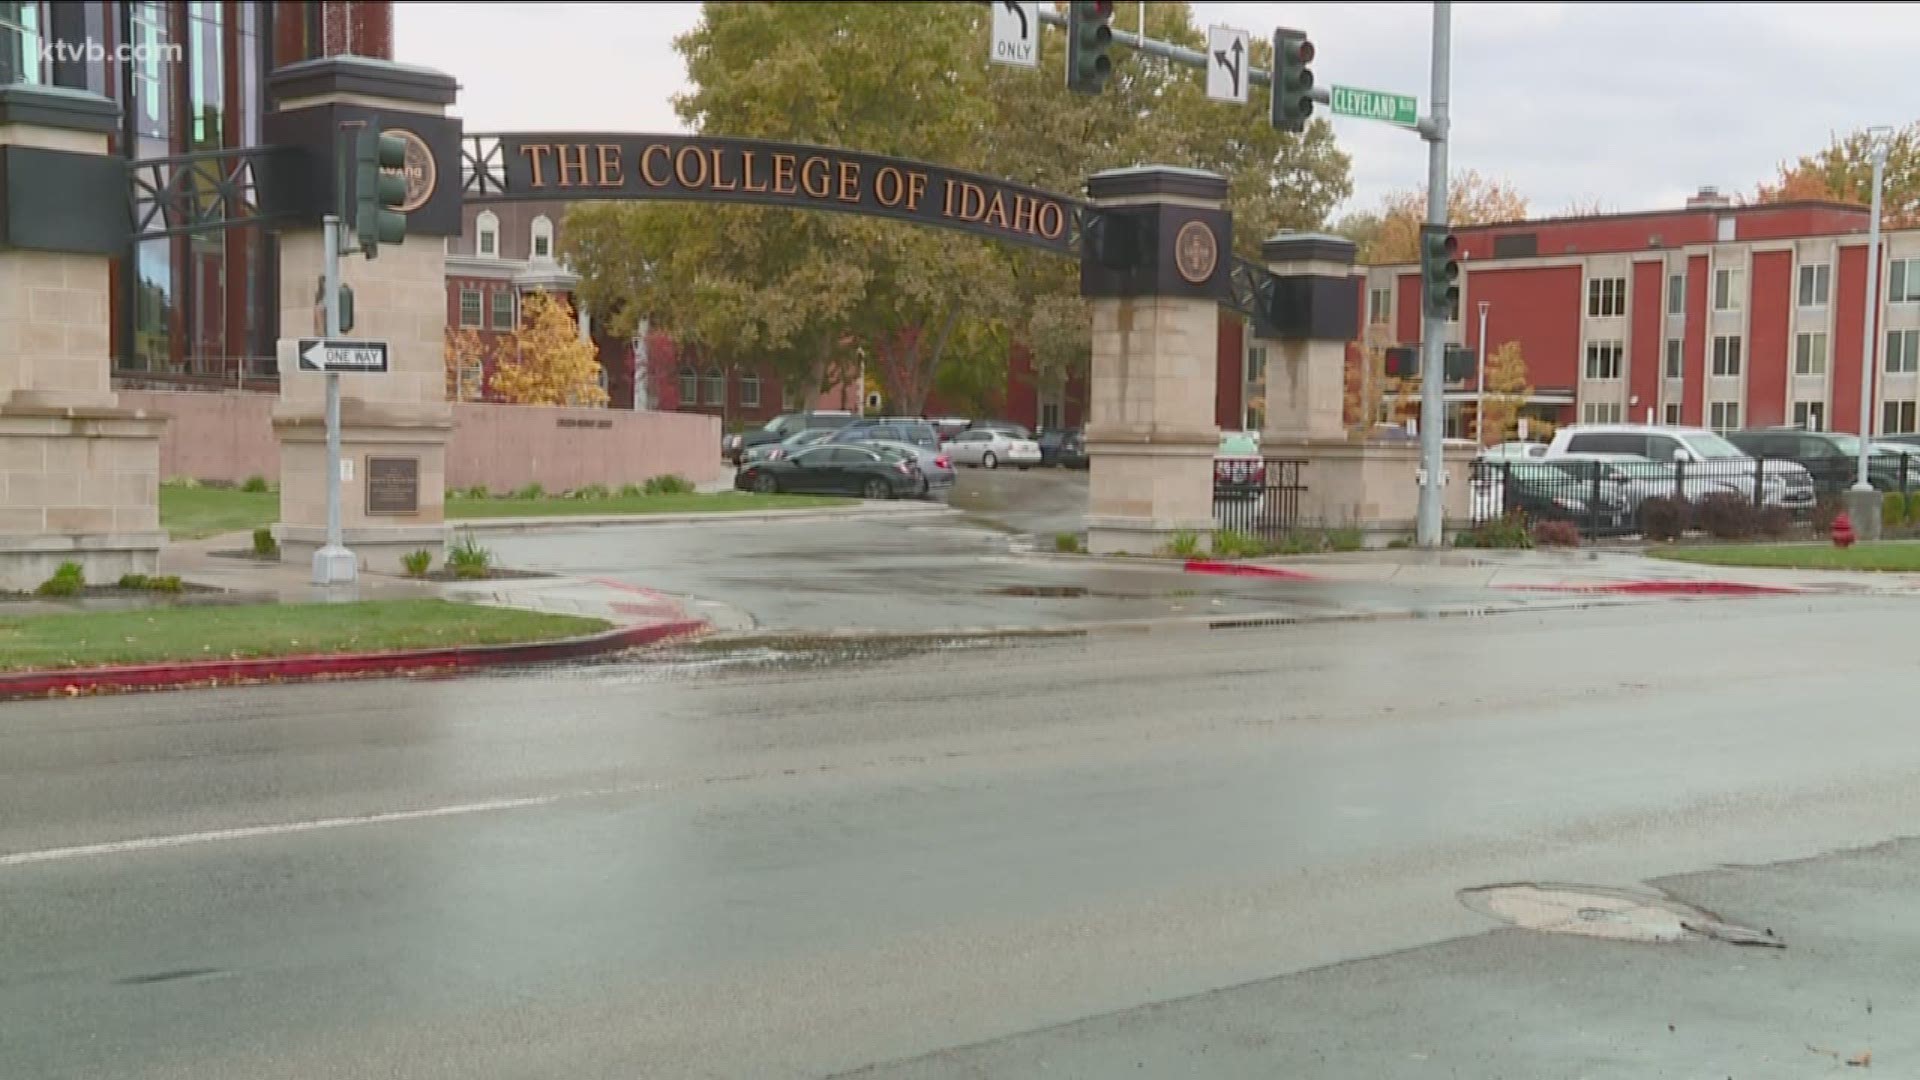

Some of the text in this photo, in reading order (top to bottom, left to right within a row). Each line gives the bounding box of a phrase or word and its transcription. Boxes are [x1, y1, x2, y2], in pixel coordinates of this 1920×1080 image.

[998, 40, 1031, 60] ONLY
[1334, 88, 1396, 119] CLEVELAND
[520, 143, 1064, 240] THE COLLEGE OF IDAHO
[326, 350, 379, 364] ONE WAY
